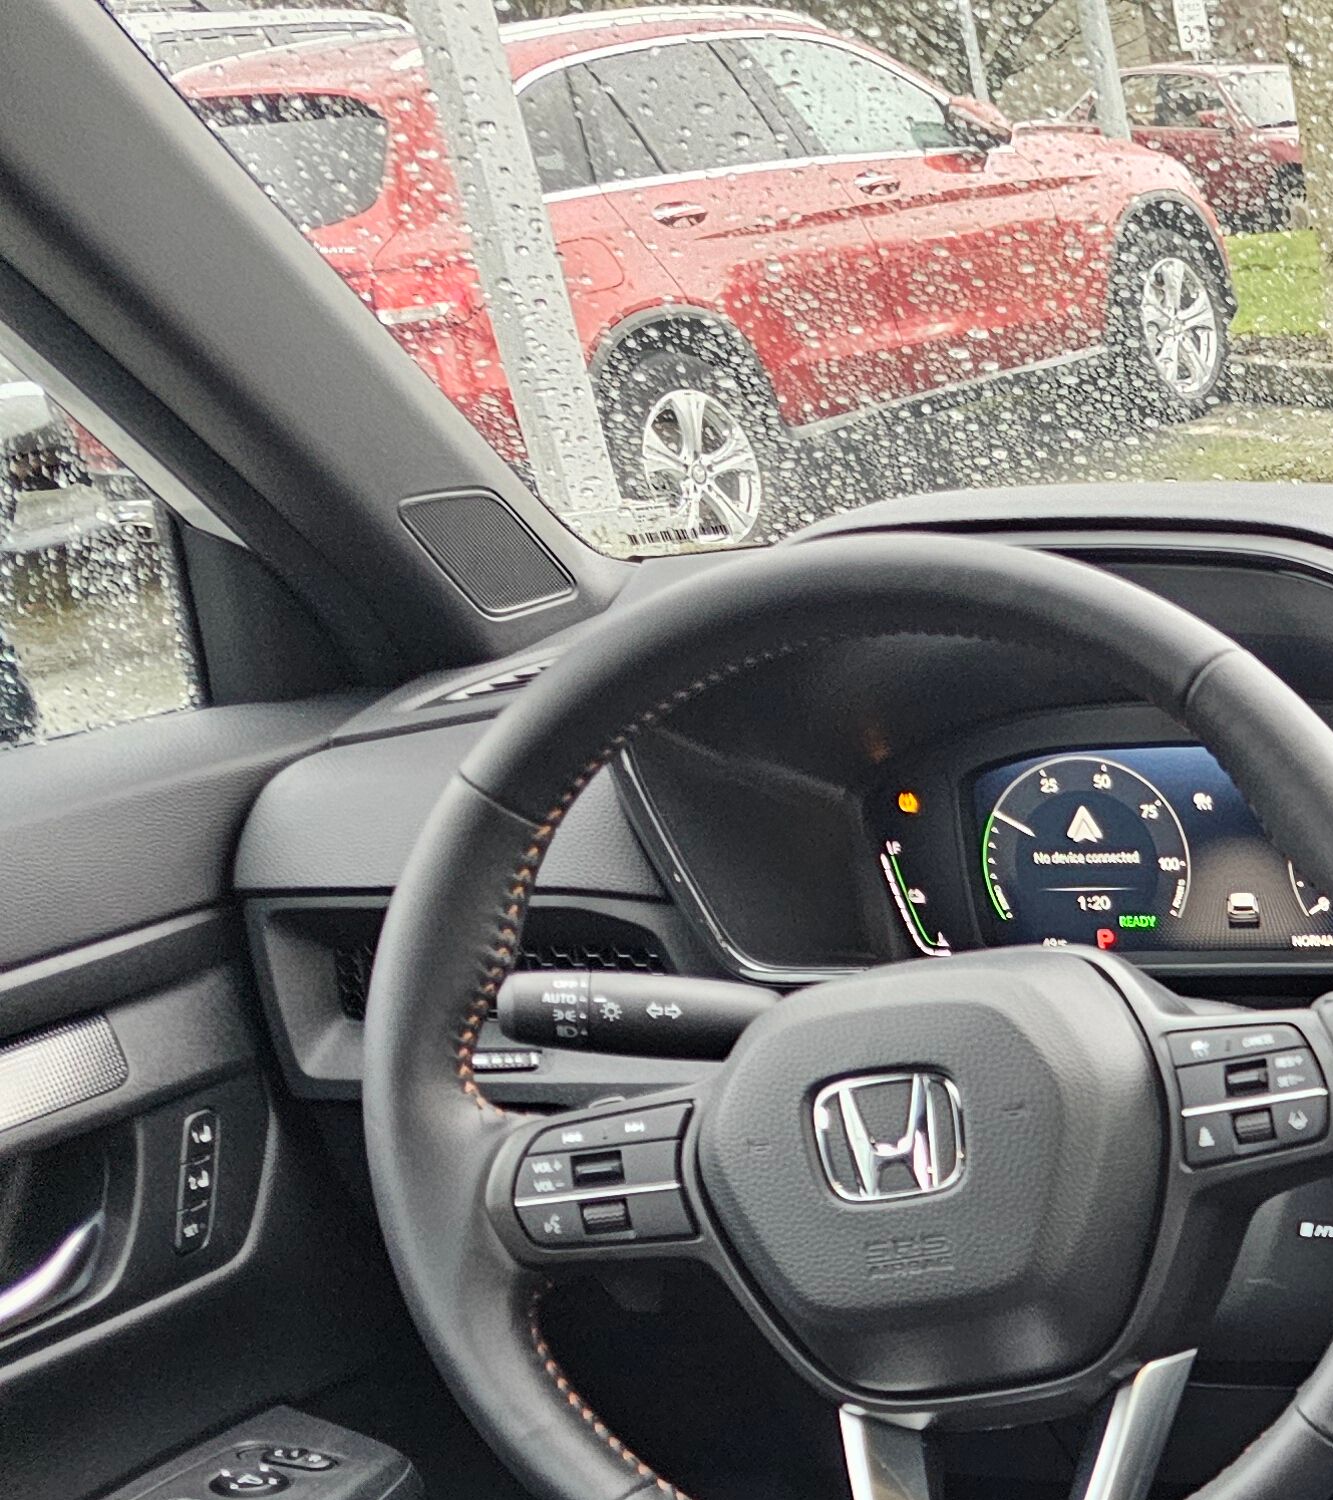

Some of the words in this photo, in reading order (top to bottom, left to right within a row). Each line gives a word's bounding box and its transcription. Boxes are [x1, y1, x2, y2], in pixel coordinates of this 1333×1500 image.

[1040, 778, 1059, 794] 25
[1093, 774, 1112, 790] 50
[1139, 803, 1159, 820] 75
[1033, 852, 1051, 865] No
[1051, 851, 1085, 865] device
[1086, 850, 1141, 864] connected
[1158, 857, 1180, 871] 100
[1077, 895, 1111, 911] 1:20
[1119, 915, 1156, 928] READY
[1097, 928, 1116, 949] P
[541, 992, 577, 1005] AUTO
